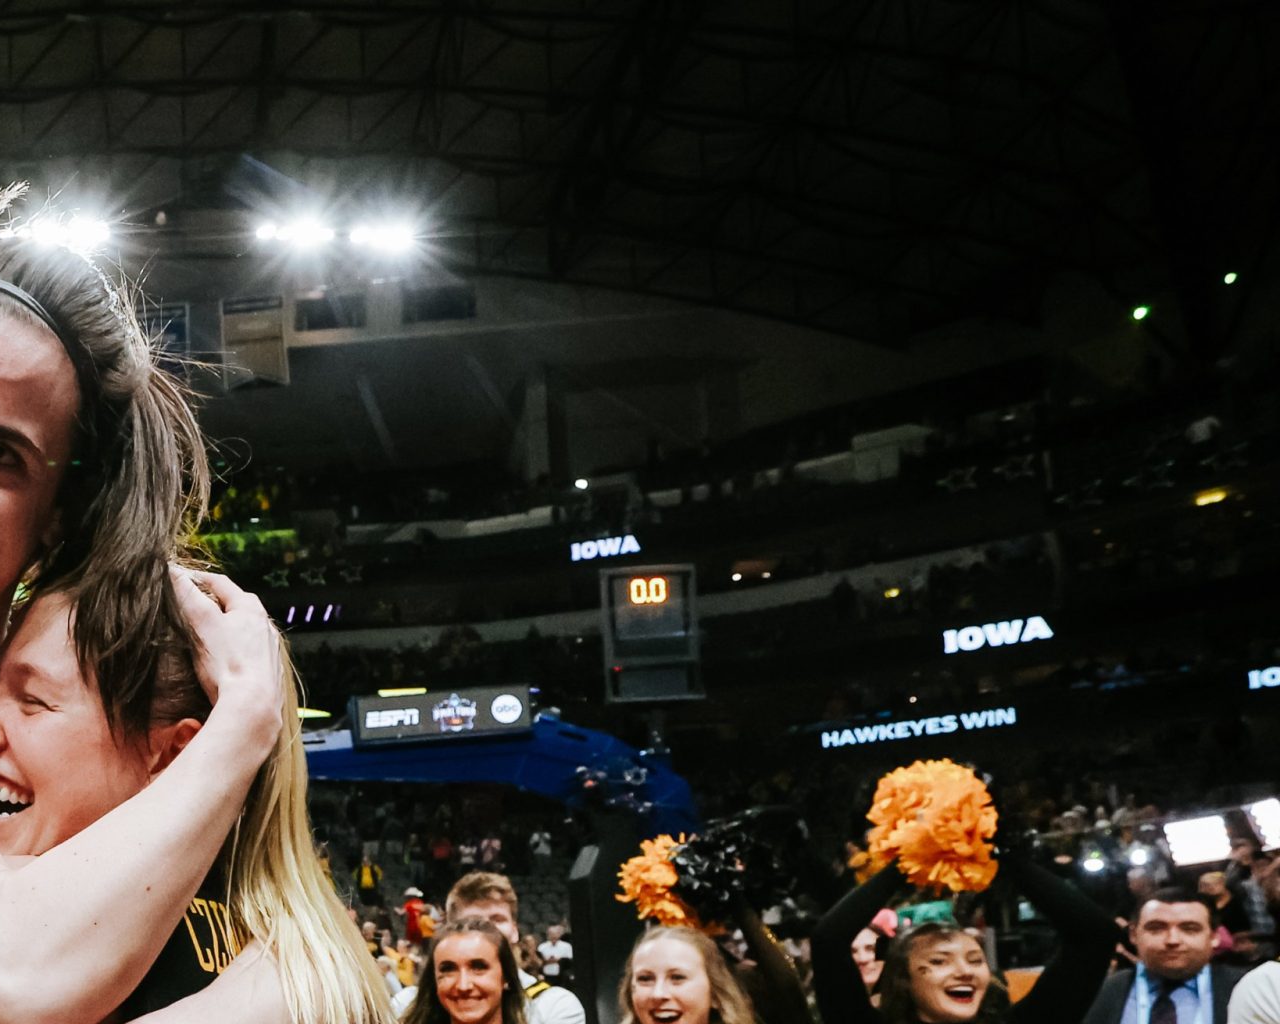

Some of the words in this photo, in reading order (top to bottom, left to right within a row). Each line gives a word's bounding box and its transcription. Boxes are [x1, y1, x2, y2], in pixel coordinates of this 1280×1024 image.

[571, 534, 641, 561] IOWA
[942, 615, 1055, 654] IOWA
[365, 708, 420, 728] ESPN
[495, 702, 519, 713] abc
[821, 714, 959, 748] HAWKEYES
[960, 706, 1017, 730] WIN
